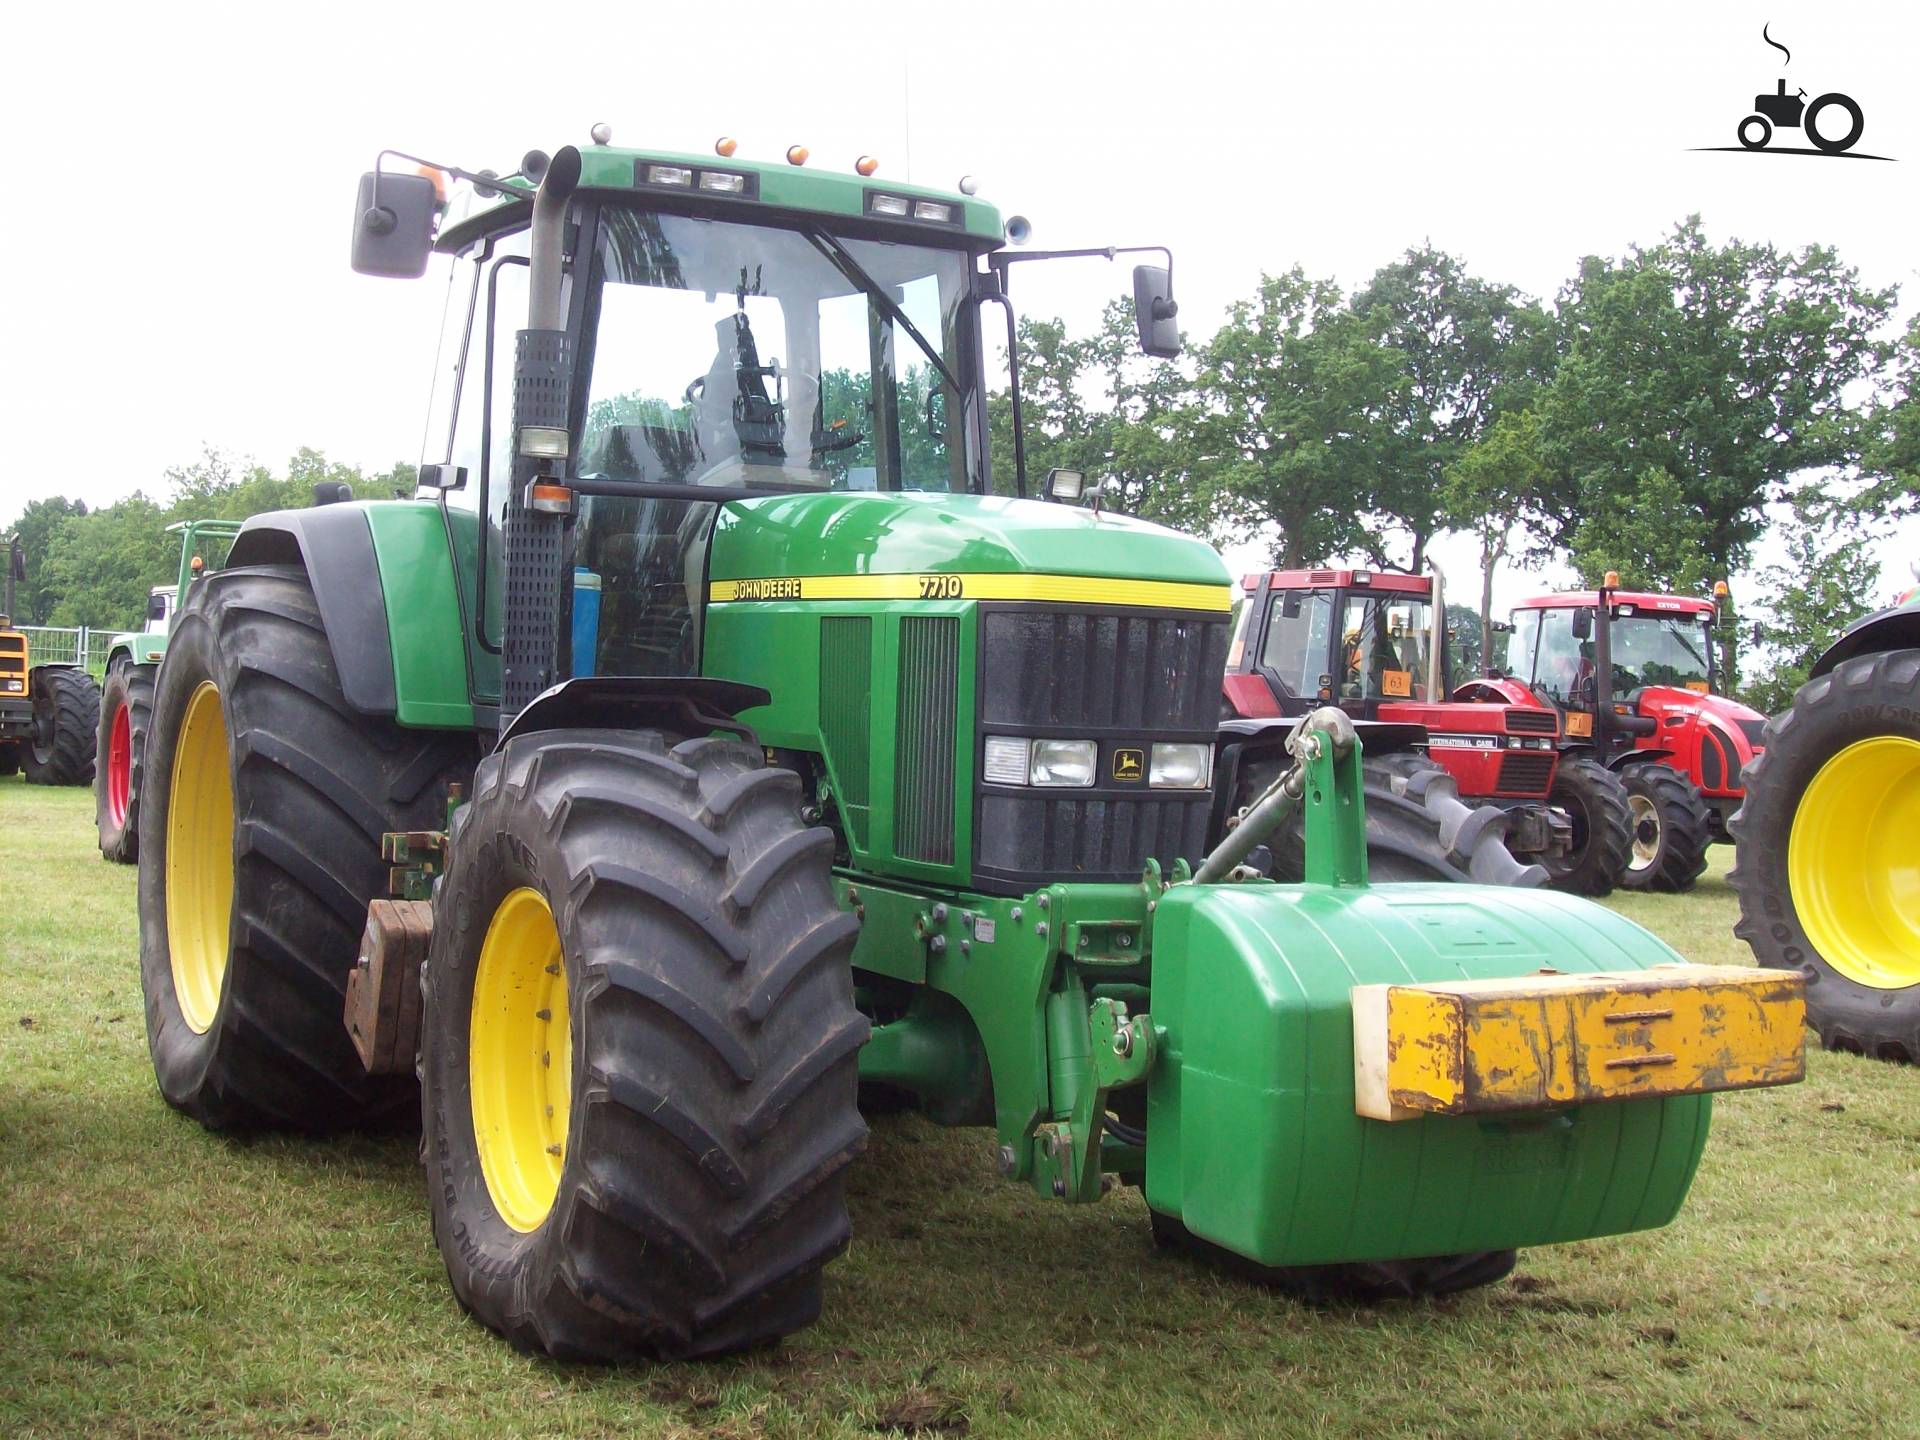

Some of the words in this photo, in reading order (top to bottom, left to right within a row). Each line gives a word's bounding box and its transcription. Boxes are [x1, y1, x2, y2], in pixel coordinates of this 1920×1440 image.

[733, 580, 761, 600] JOHN
[762, 578, 802, 599] DEERE
[919, 575, 963, 599] 7710
[1390, 676, 1402, 689] 63
